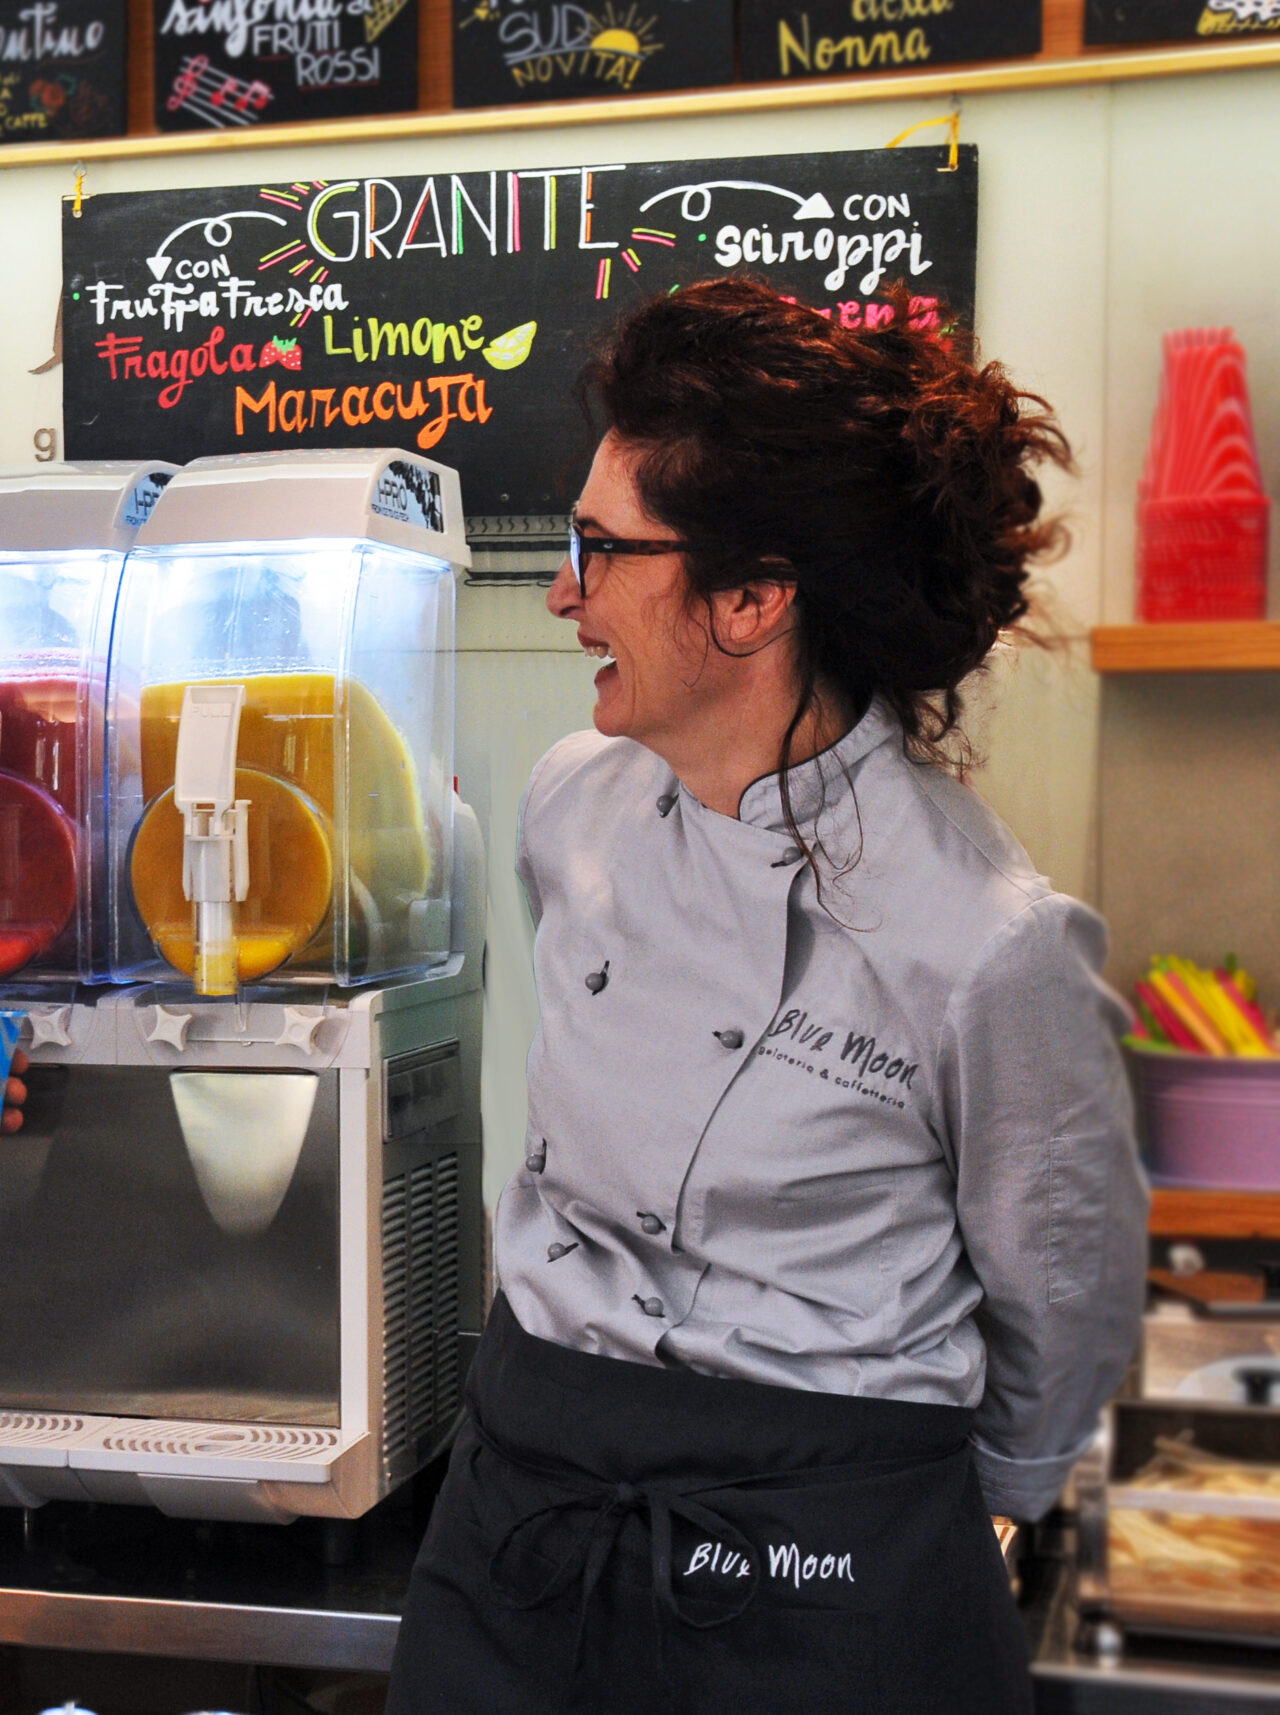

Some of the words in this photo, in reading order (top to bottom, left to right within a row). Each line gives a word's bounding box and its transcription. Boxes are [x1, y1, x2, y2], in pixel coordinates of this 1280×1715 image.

[252, 20, 340, 55] FRUTTI
[499, 4, 591, 59] SUD
[778, 13, 931, 75] Nonna
[296, 47, 380, 87] ROSSI
[307, 165, 627, 263] GRANITE
[843, 193, 910, 221] CON
[174, 254, 231, 280] CON
[323, 314, 485, 364] Limone
[94, 326, 259, 409] Fragola
[768, 1009, 834, 1051] Blue
[840, 1031, 919, 1090] Moon
[819, 1068, 830, 1081] &
[834, 1076, 906, 1109] caffetteria
[683, 1542, 751, 1578] Blue
[768, 1543, 855, 1590] Moon
